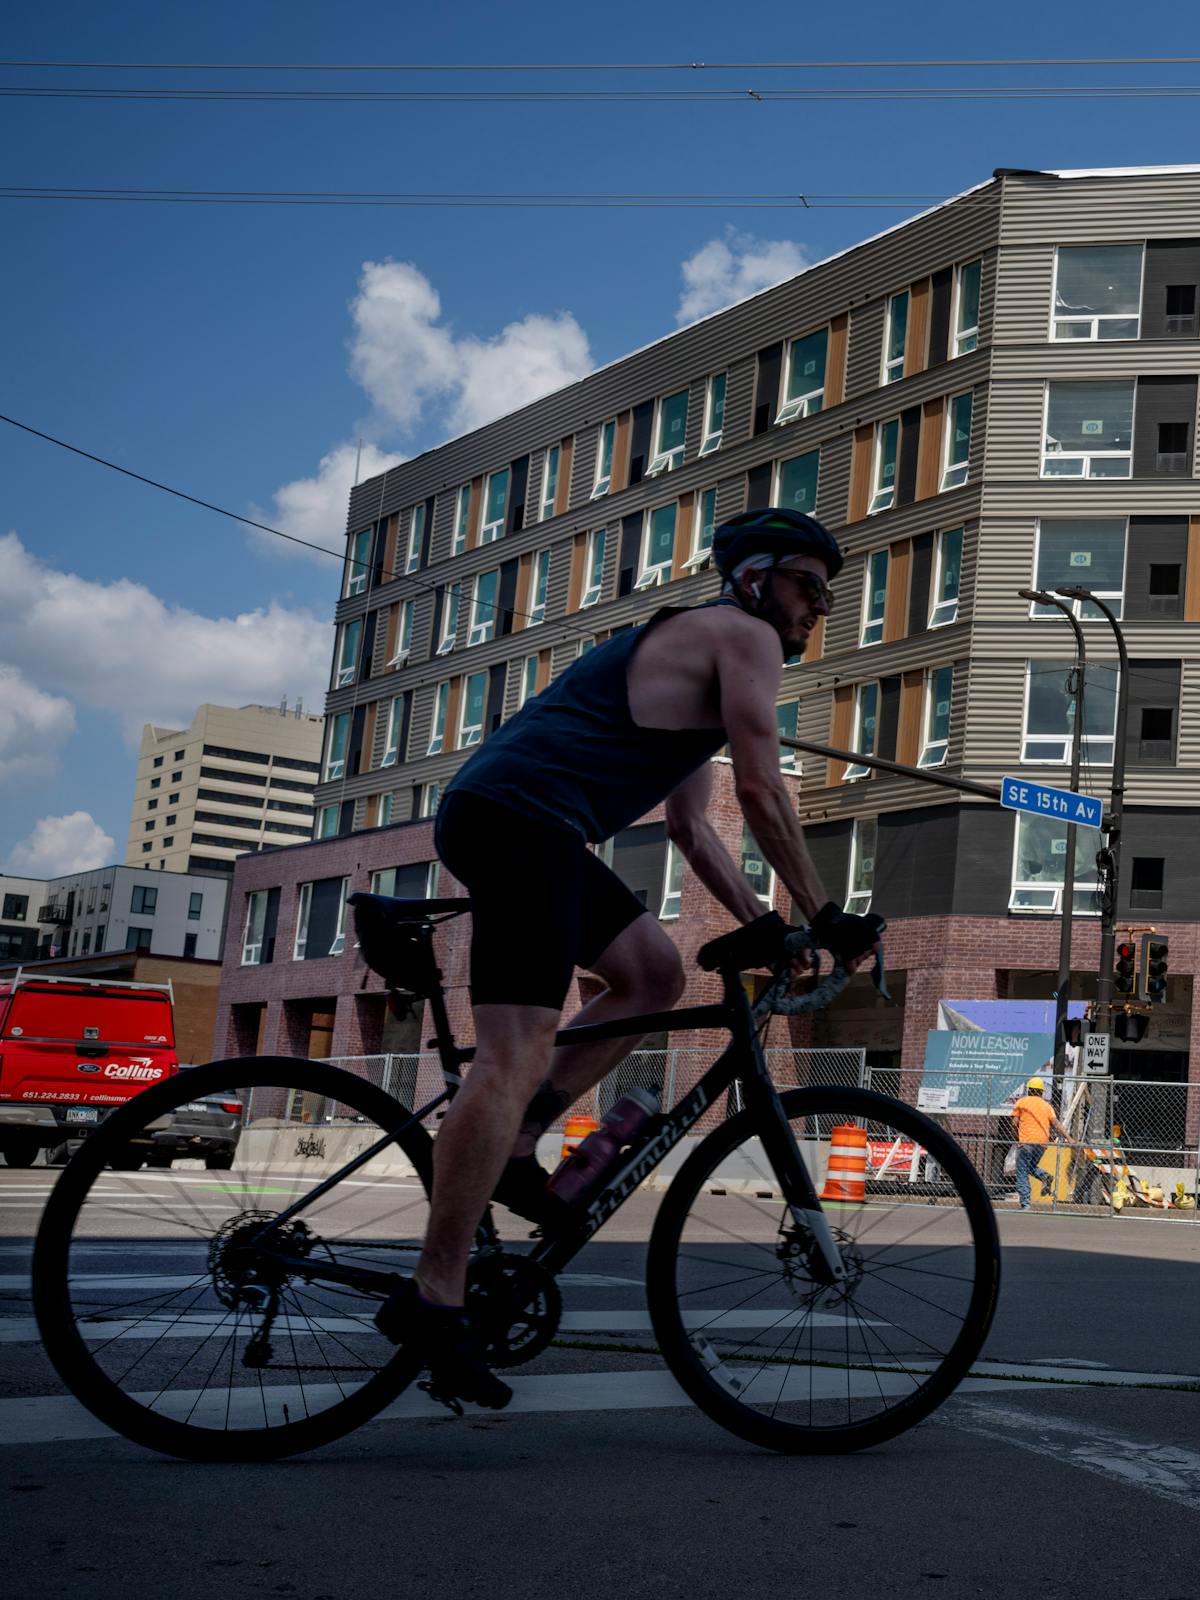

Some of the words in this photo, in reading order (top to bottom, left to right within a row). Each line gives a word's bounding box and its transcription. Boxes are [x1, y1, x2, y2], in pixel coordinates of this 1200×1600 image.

[1009, 786, 1028, 804] SE
[1036, 792, 1068, 813] 15th
[1075, 802, 1095, 819] Av
[951, 1035, 980, 1049] NOW
[981, 1036, 1030, 1051] LEASING
[1088, 1036, 1106, 1046] ONE
[1087, 1048, 1106, 1058] WAY
[104, 1063, 163, 1078] Collins
[22, 1091, 80, 1101] 651.224.2833
[90, 1094, 133, 1103] collinsmn.c
